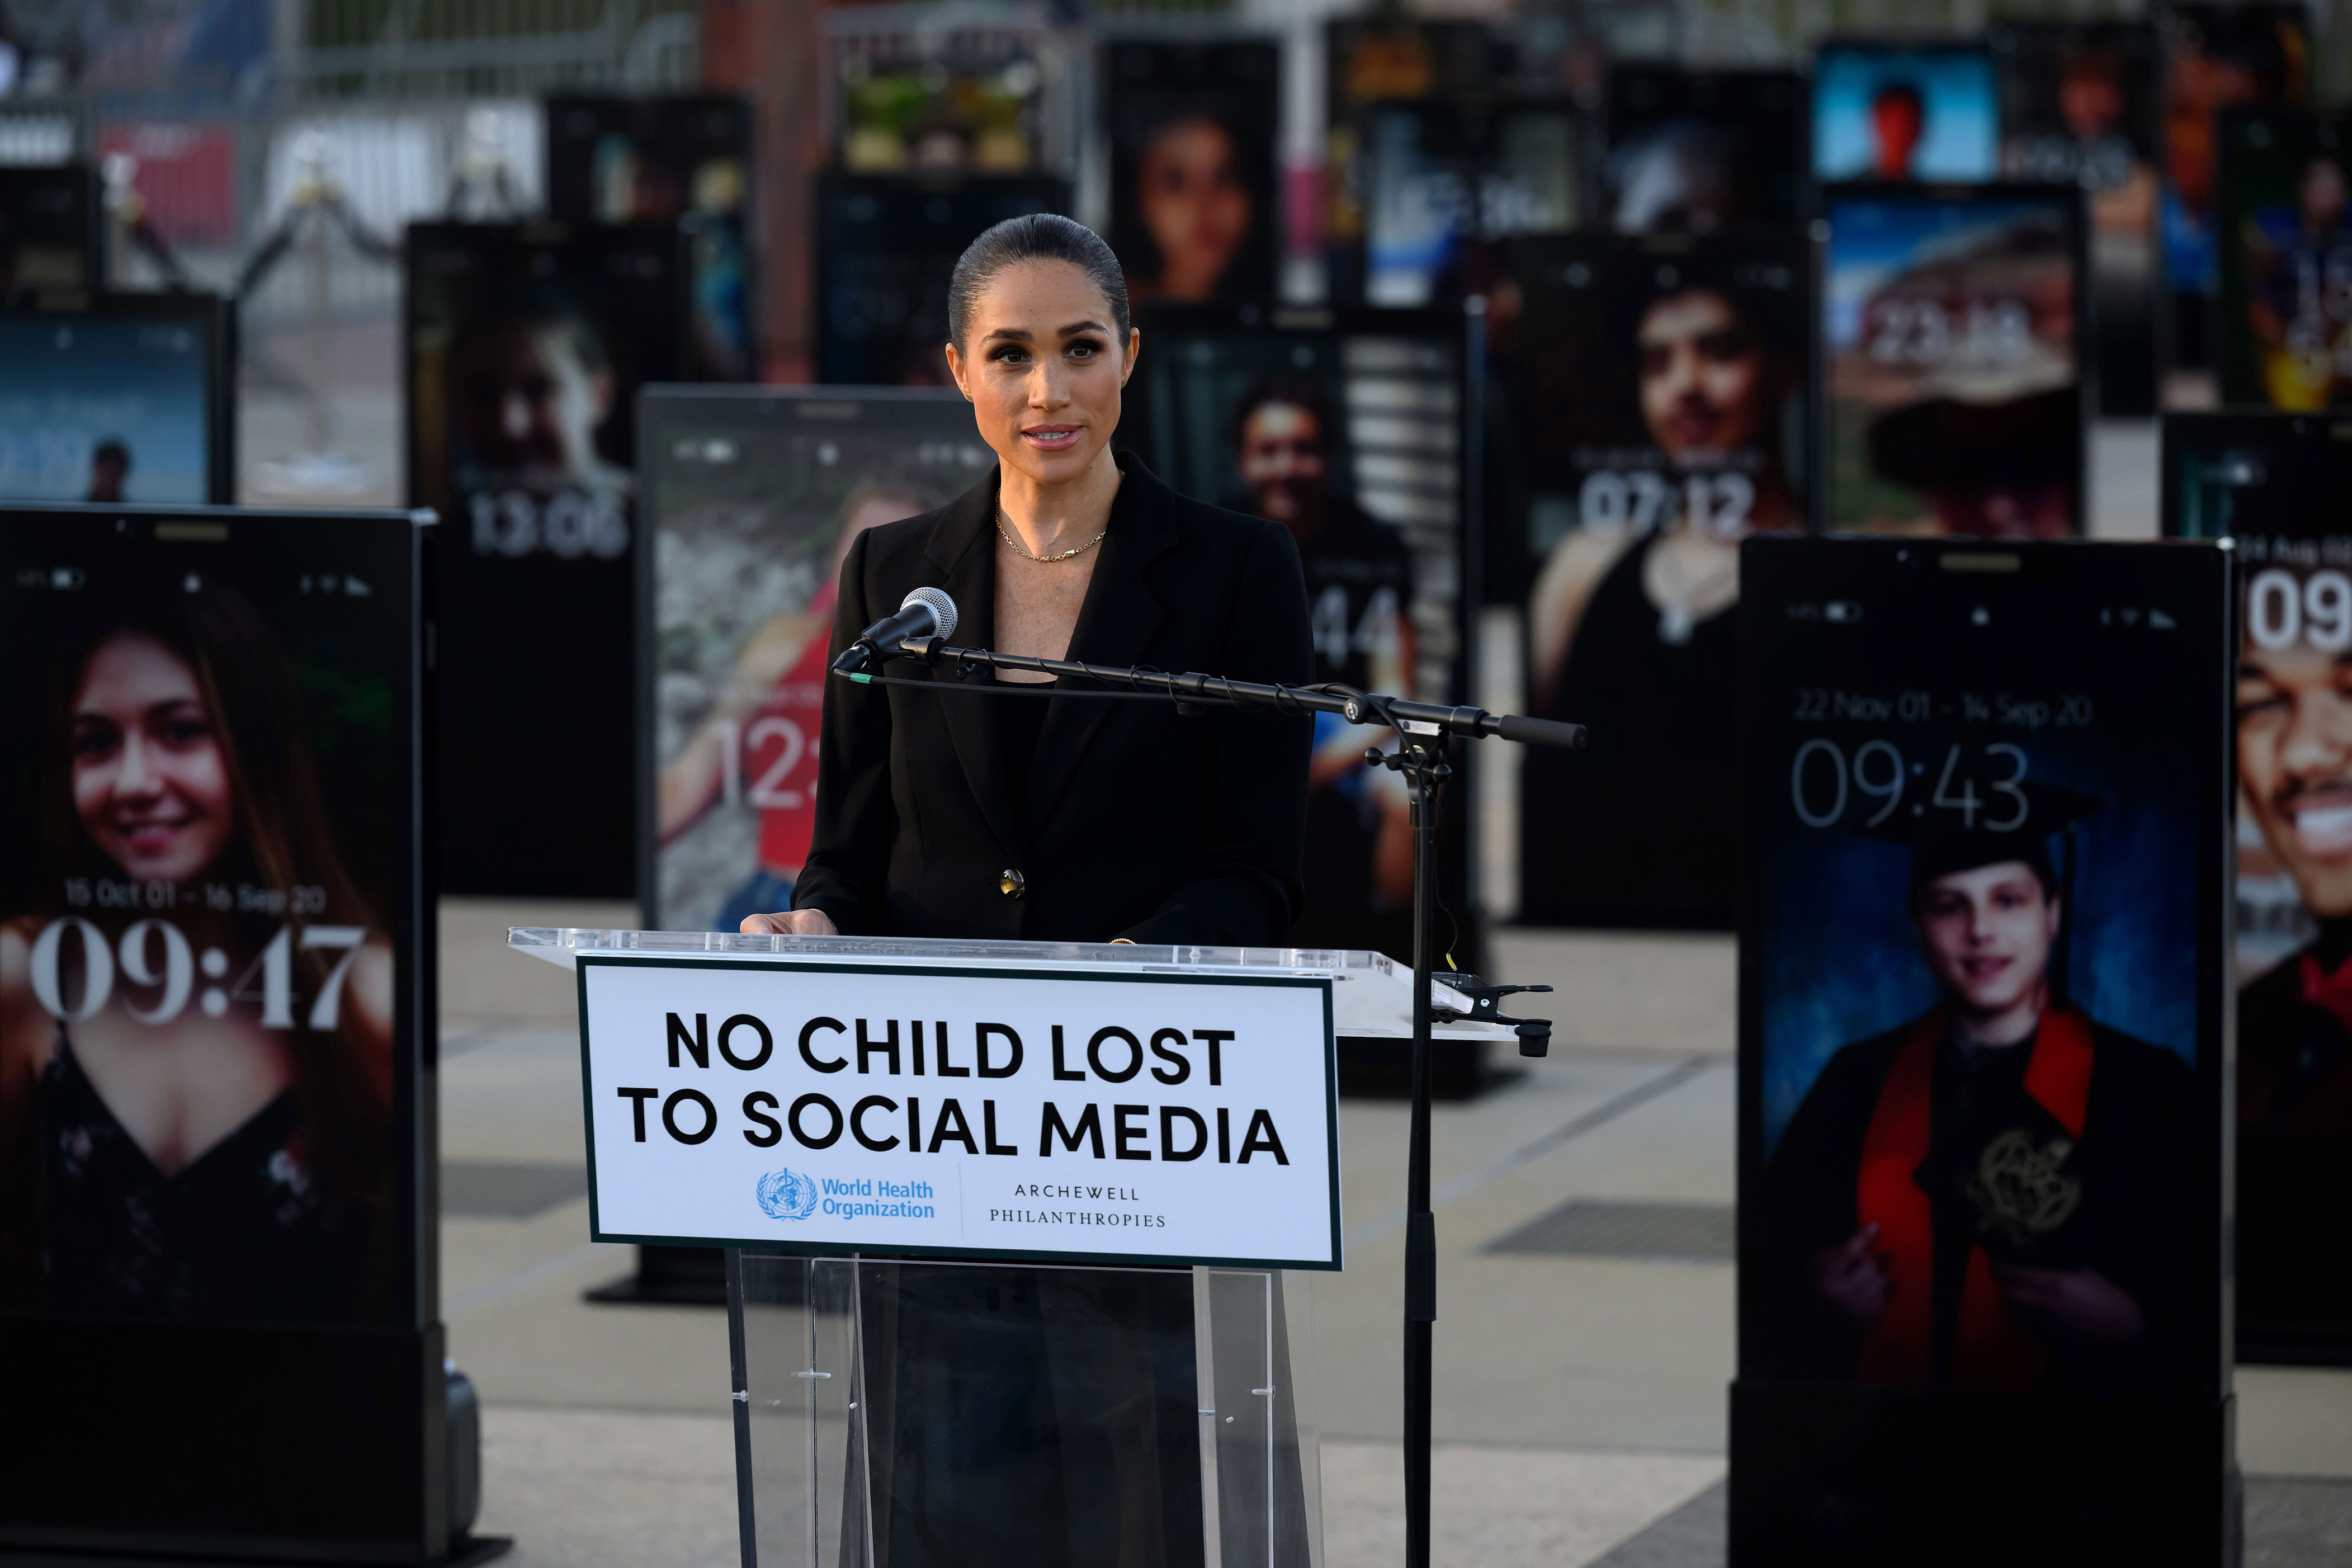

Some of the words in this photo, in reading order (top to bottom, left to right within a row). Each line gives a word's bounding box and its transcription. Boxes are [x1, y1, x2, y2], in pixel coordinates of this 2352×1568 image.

[1579, 470, 1756, 538] 07:12
[1794, 687, 1827, 721] 22
[1834, 689, 1893, 721] Nov
[1897, 689, 1930, 721] 01
[1963, 692, 1989, 721] 14
[1996, 692, 2050, 732] Sep
[2055, 693, 2093, 726] 20
[1791, 738, 2029, 833] 09:43
[65, 879, 92, 907] 15
[96, 880, 139, 909] Oct
[146, 883, 176, 909] 01
[204, 884, 233, 911] 16
[237, 886, 286, 917] Sep
[290, 886, 326, 914] 20
[29, 915, 367, 1031] 09:47
[667, 1013, 773, 1070] NO
[799, 1017, 1023, 1078] CHILD
[1052, 1025, 1235, 1085] LOST
[617, 1087, 717, 1145] TO
[743, 1091, 1017, 1155] SOCIAL
[1040, 1102, 1290, 1165] MEDIA
[821, 1178, 871, 1196] World
[879, 1180, 933, 1198] Health
[823, 1198, 934, 1220] Organization
[1014, 1184, 1139, 1200] ARCHEWELL
[989, 1209, 1166, 1228] PHILANTHROPIES
